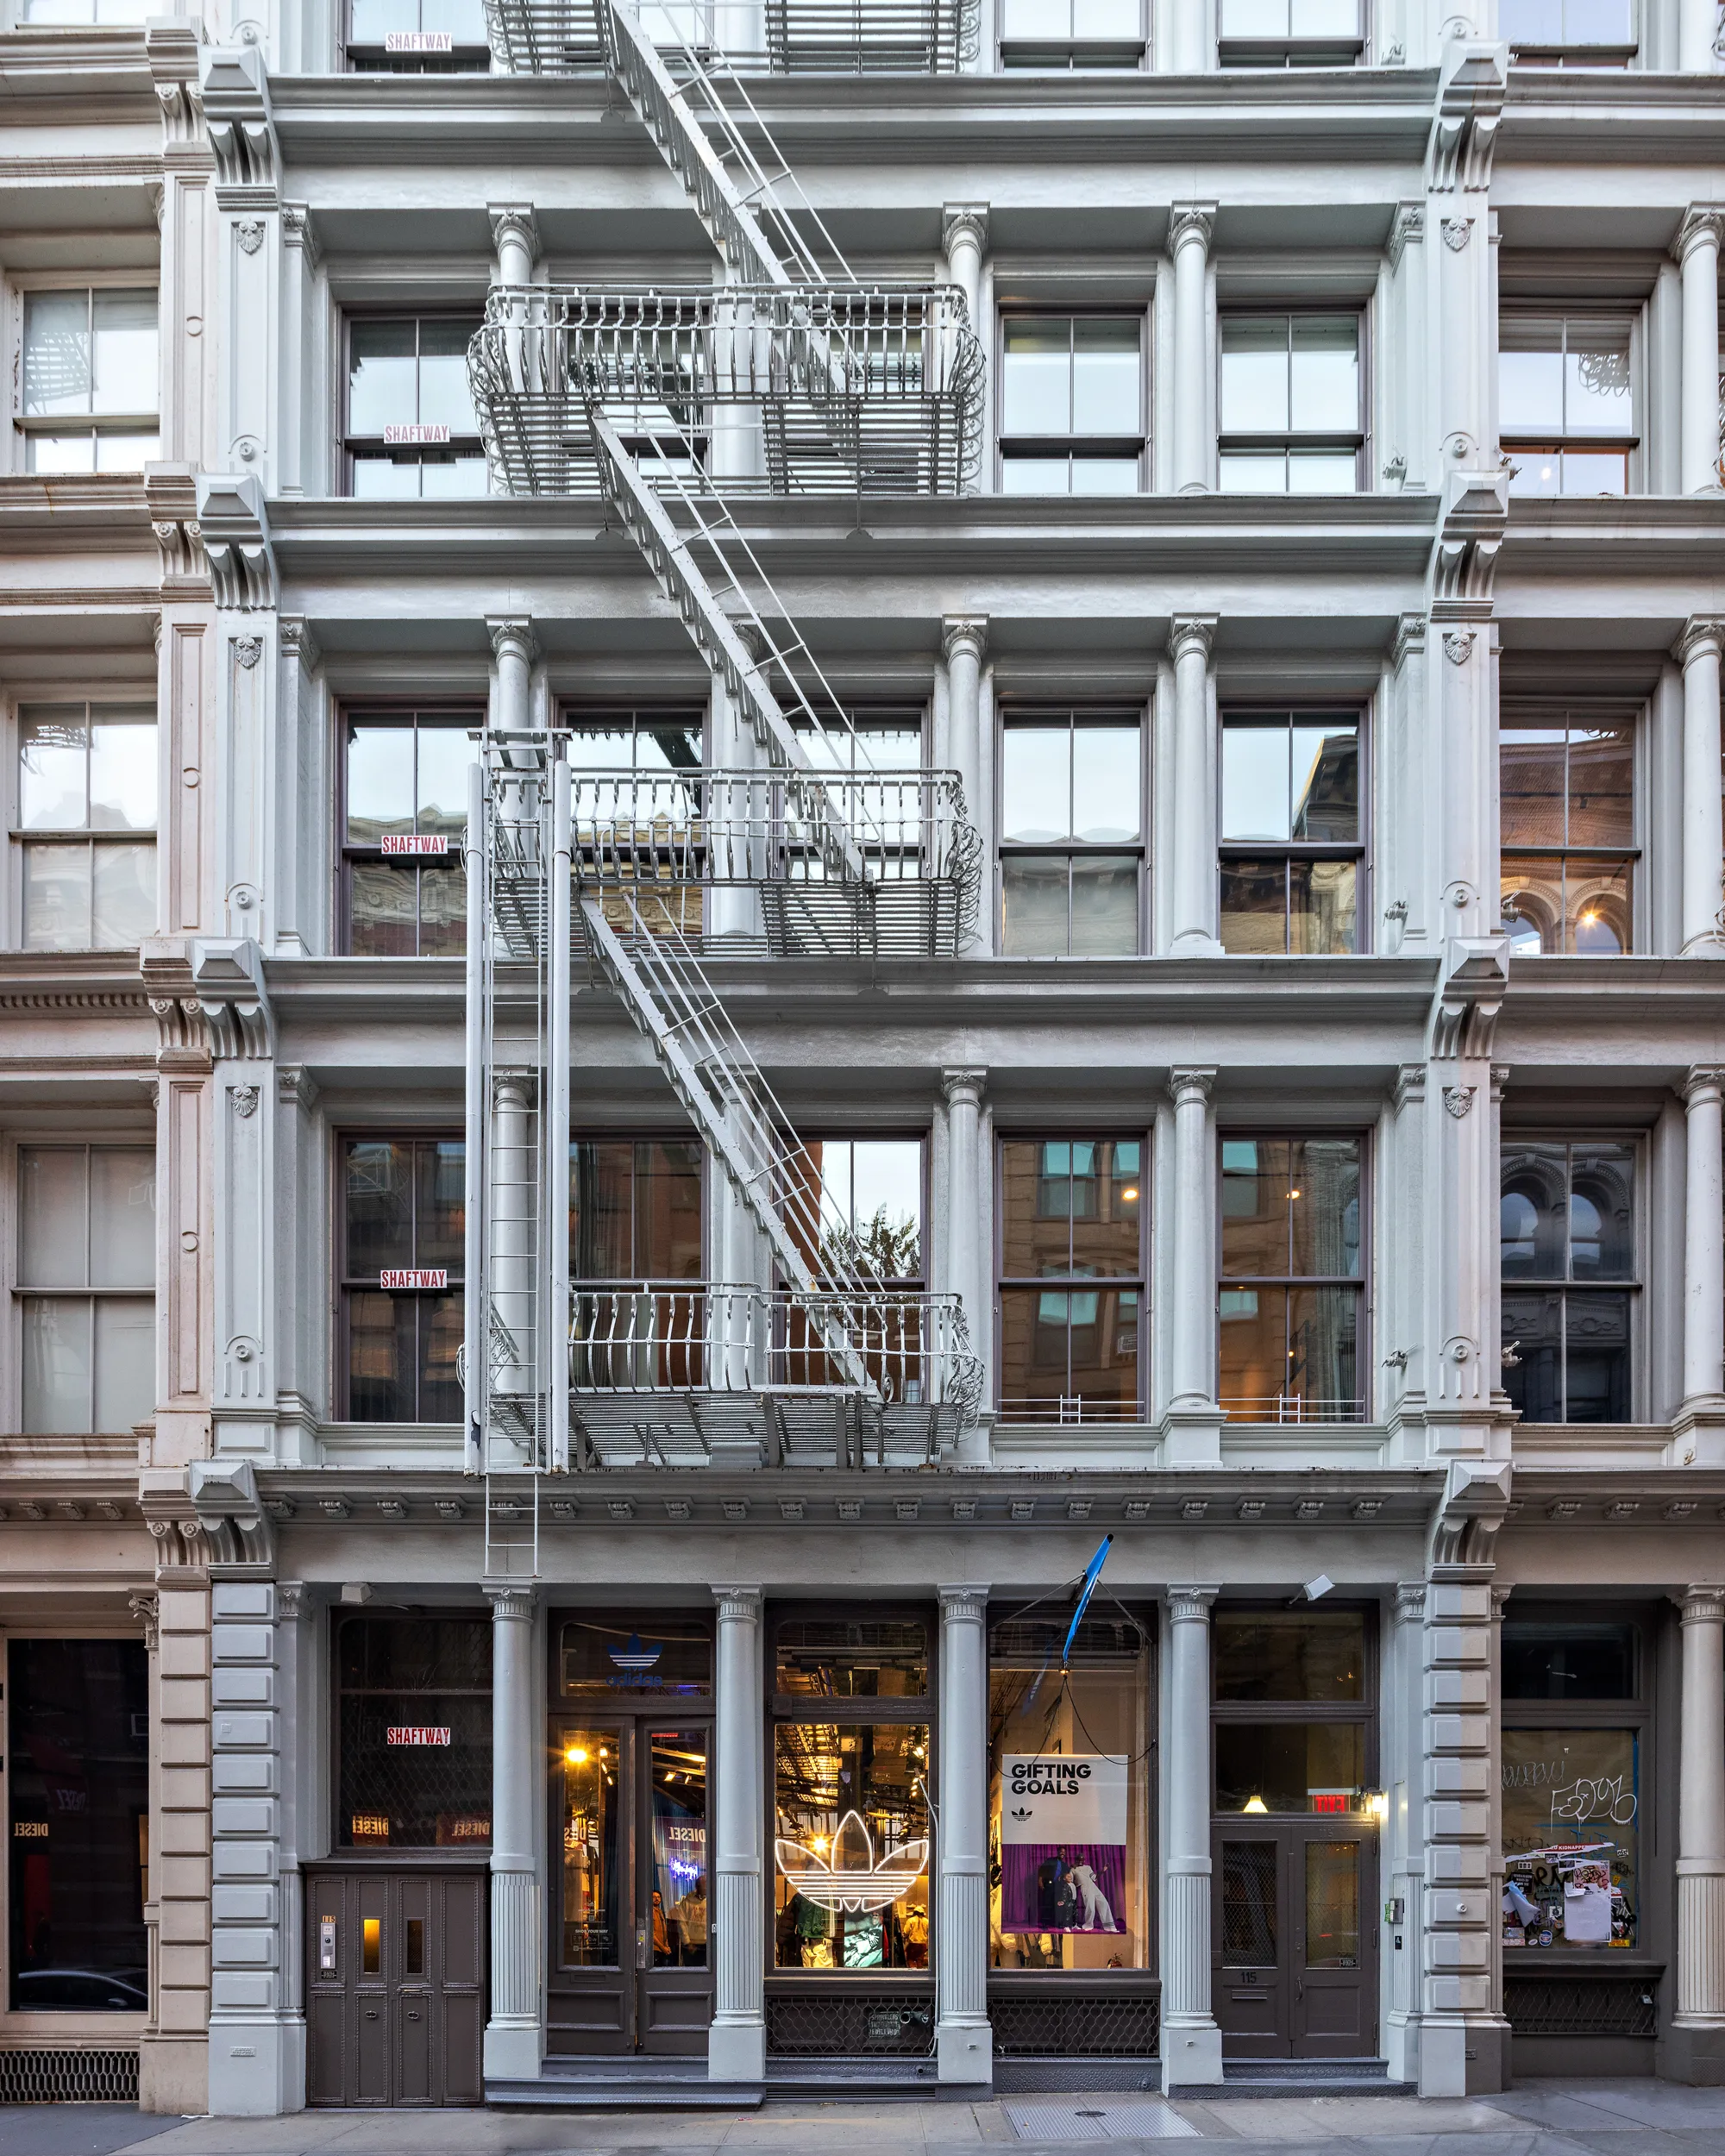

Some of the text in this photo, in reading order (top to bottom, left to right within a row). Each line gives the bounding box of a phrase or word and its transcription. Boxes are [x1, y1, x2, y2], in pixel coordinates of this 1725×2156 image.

[387, 34, 450, 49] SHAFTWAY
[385, 425, 448, 442] SHAFTWAY
[382, 836, 446, 853] SHAFTWAY
[381, 1270, 445, 1288] SHAFTWAY
[605, 1672, 663, 1687] adidas
[387, 1727, 449, 1744] SHAFTWAY
[1011, 1764, 1092, 1779] GIFTING
[1011, 1779, 1080, 1795] GOALS
[1241, 1971, 1257, 1984] 115
